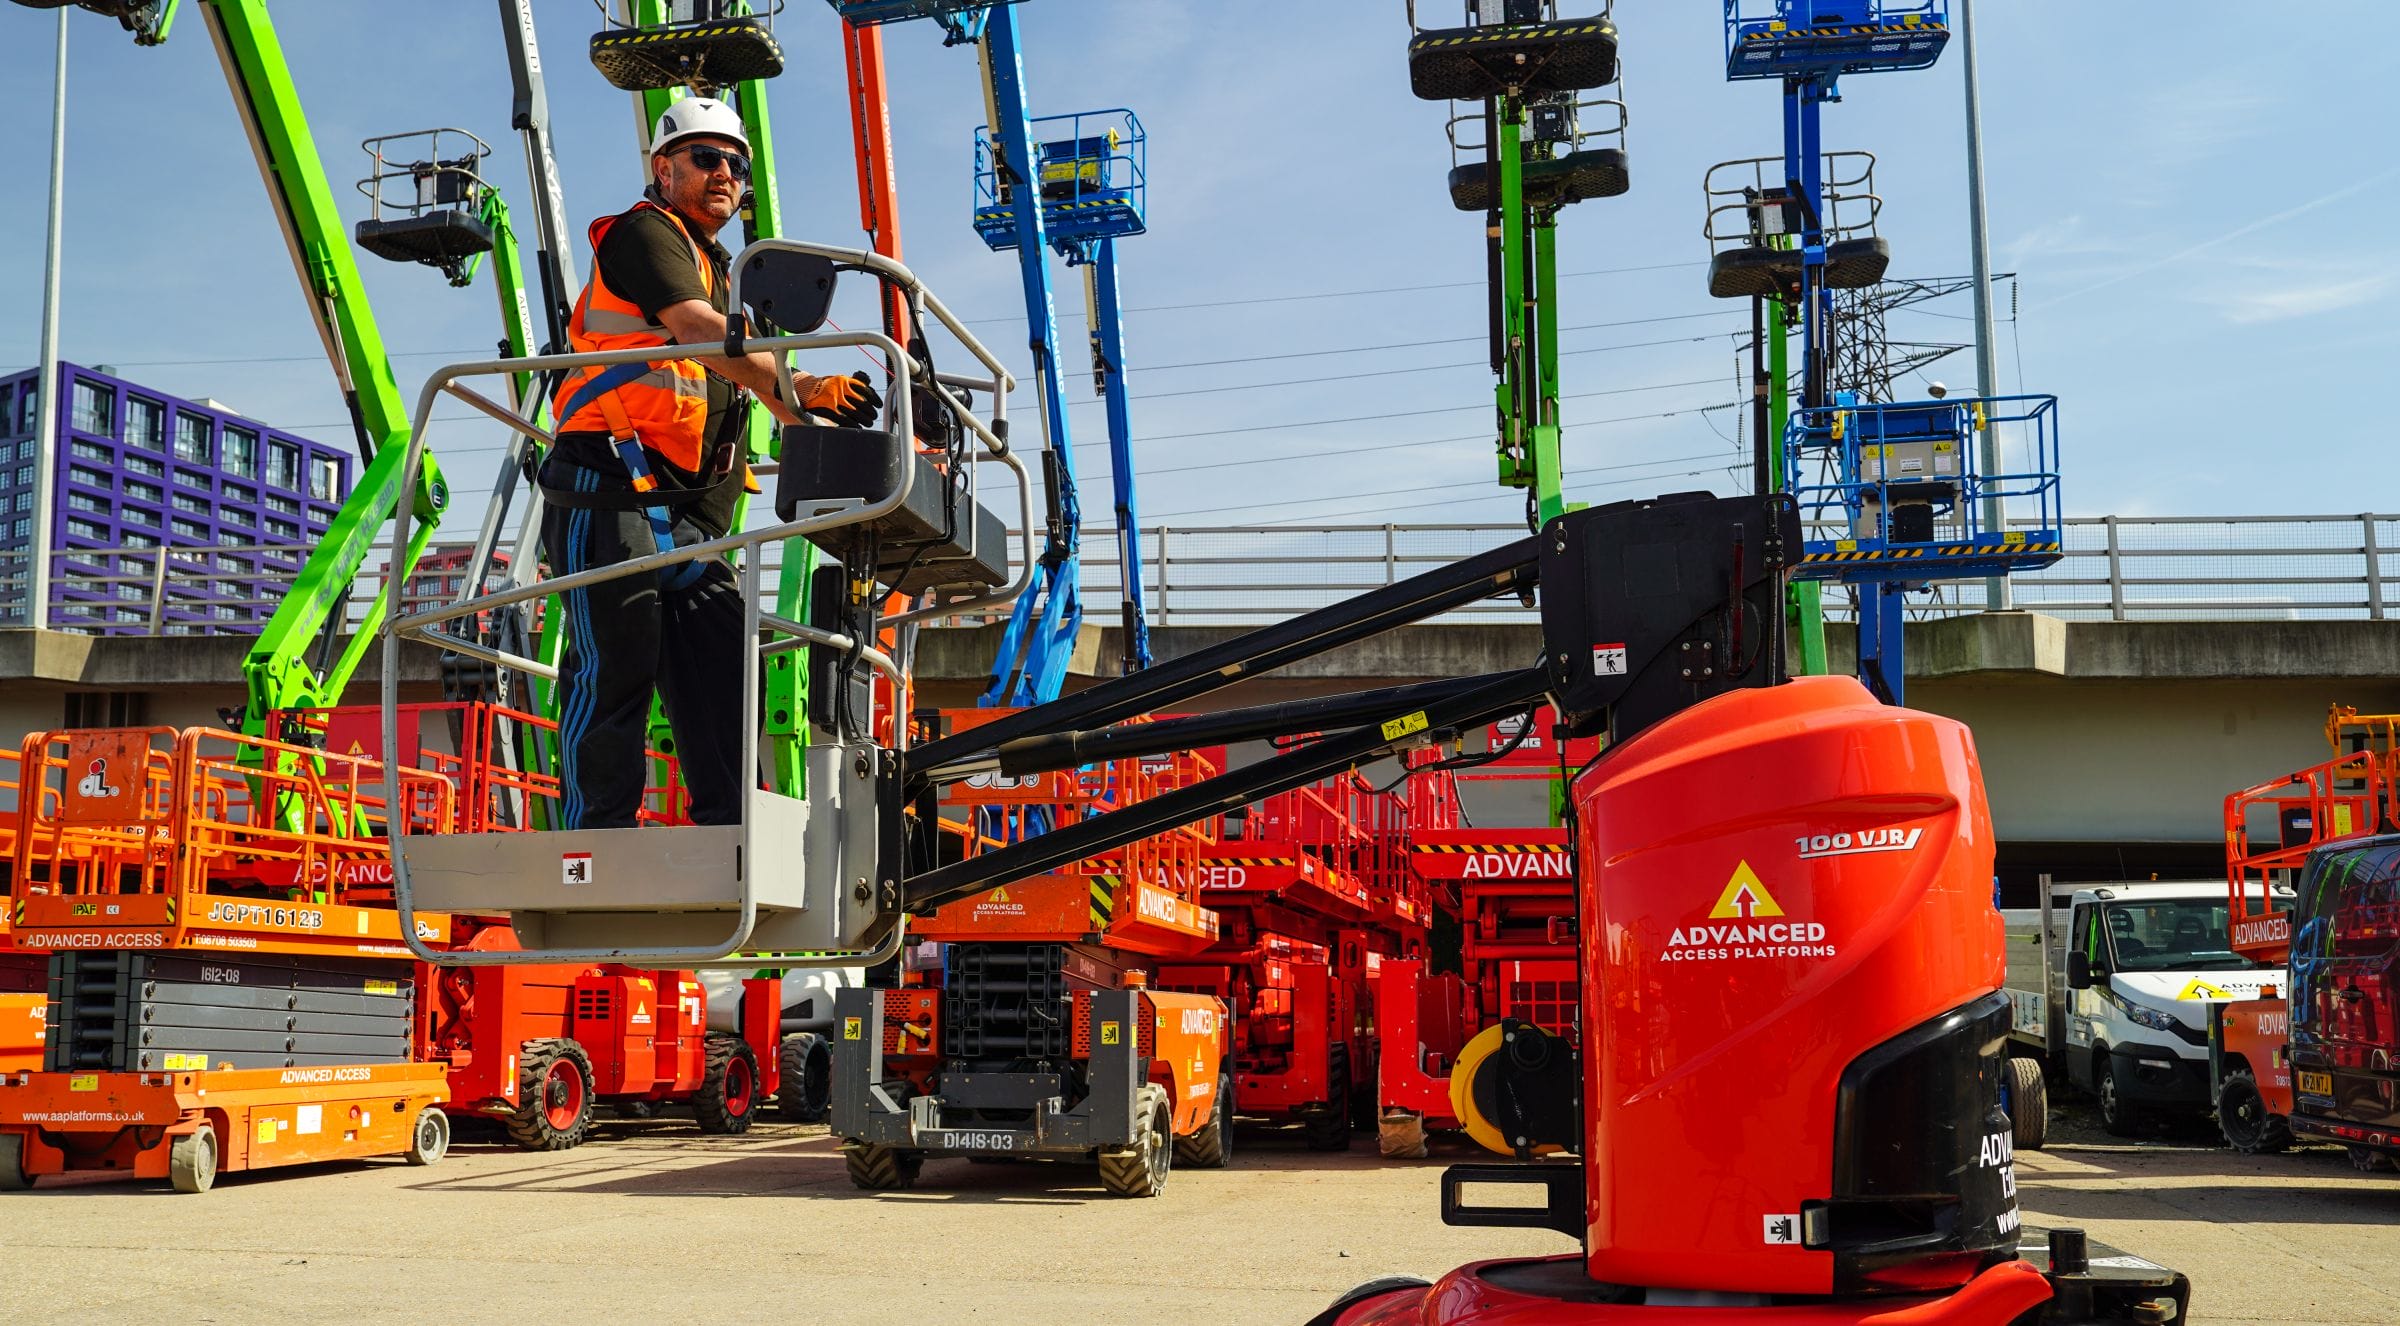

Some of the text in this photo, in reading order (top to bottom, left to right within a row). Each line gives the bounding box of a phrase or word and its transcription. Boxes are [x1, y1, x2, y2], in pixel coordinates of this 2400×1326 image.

[882, 102, 896, 193] ADVANCED
[540, 130, 569, 254] SKYJACK
[1046, 291, 1065, 395] ADVANCED
[1795, 829, 1905, 853] 100 VJR
[73, 902, 96, 915] IPAF
[208, 902, 322, 929] JCPT1612B
[976, 903, 1024, 911] ADVANCED
[1139, 887, 1176, 923] ADVANCED
[26, 933, 163, 948] ADVANCED ACCESS
[1667, 922, 1826, 947] ADVANCED
[2235, 918, 2288, 945] ADVANCED
[1660, 944, 1836, 962] ACCESS PLATFORMS
[29, 1006, 47, 1019] AD
[1181, 1008, 1213, 1035] ADVANCED
[280, 1067, 371, 1084] ADVANCED ACCESS
[23, 1110, 145, 1124] www.aaplatforms.co.uk
